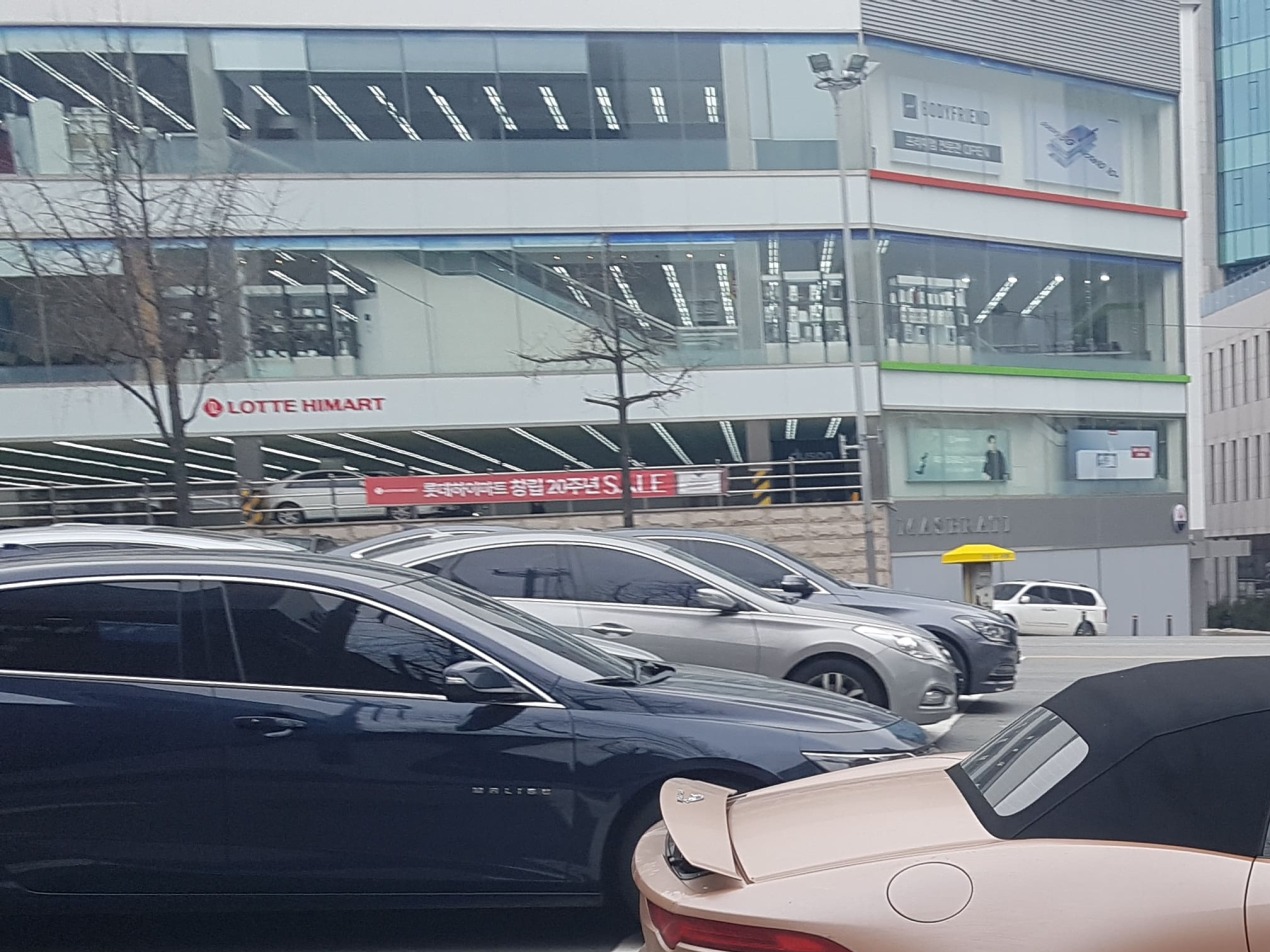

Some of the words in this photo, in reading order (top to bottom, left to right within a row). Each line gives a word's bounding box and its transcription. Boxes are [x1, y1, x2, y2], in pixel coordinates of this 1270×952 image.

[227, 399, 298, 414] LOTTE
[301, 397, 386, 413] HIMART
[422, 481, 509, 498] 롯데하이마트
[510, 478, 545, 497] 창립
[546, 476, 601, 496] 20주년
